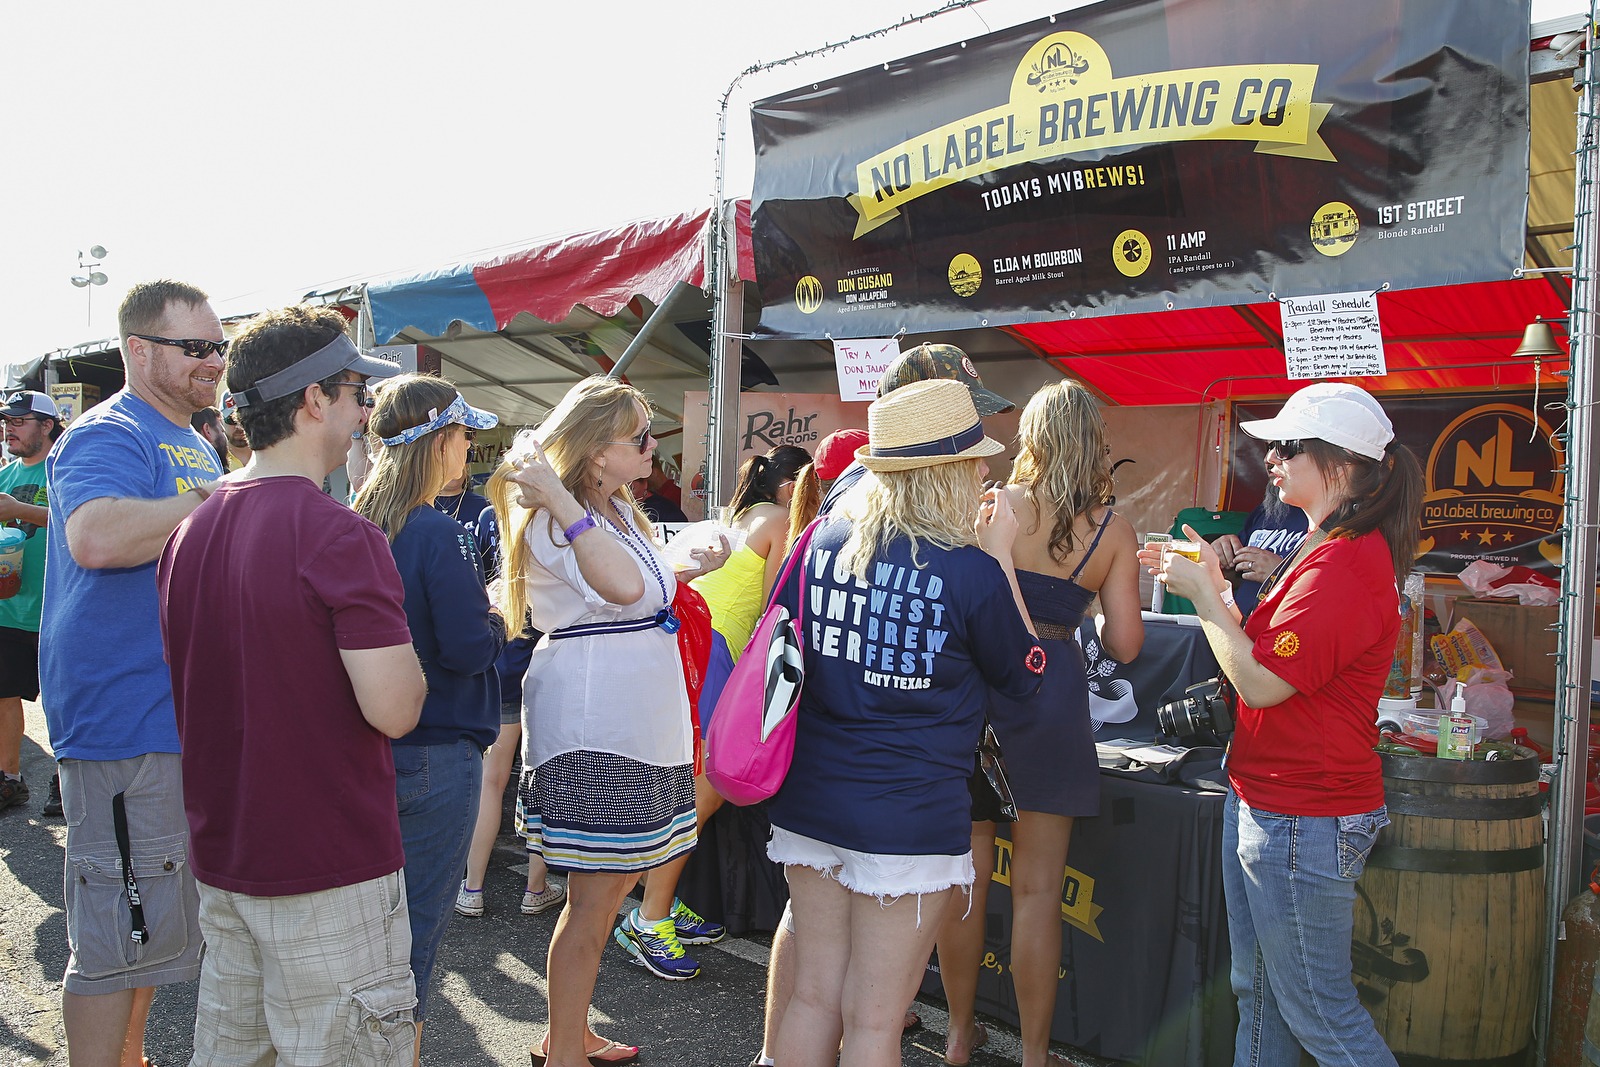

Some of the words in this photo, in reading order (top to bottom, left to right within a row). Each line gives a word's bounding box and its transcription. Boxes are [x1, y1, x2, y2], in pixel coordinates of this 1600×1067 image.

[1047, 47, 1066, 68] NL
[870, 153, 912, 202] NO
[922, 114, 1024, 181] LABEL
[1038, 79, 1220, 146] BREWING
[1231, 78, 1292, 126] CO
[981, 178, 1042, 211] TODAYS
[1048, 165, 1145, 194] MVBREWS!
[1378, 205, 1402, 224] 1ST
[1408, 196, 1464, 220] STREET
[1166, 234, 1176, 250] 11
[1180, 231, 1206, 250] AMP
[1378, 228, 1408, 240] Blonde
[1411, 223, 1444, 236] Randall
[993, 257, 1020, 274] ELDA
[1022, 254, 1032, 270] M
[1034, 248, 1082, 268] BOURBON
[1168, 256, 1181, 264] IPA
[1184, 252, 1211, 262] Randall
[1202, 264, 1215, 272] goes
[848, 267, 880, 276] PRESENTING
[996, 277, 1014, 285] Barrel
[1016, 275, 1030, 284] Aged
[1032, 273, 1046, 281] Milk
[1048, 271, 1064, 279] Stout
[838, 278, 855, 292] DON
[858, 273, 893, 290] GUSANO
[846, 294, 858, 304] DON
[859, 289, 888, 302] JALAPEÑO
[1287, 300, 1326, 314] Randall
[1332, 298, 1370, 309] Schedule
[838, 306, 850, 314] Aged
[859, 303, 876, 311] Mezcal
[840, 347, 858, 360] TRY
[865, 351, 872, 360] A
[844, 366, 864, 374] DON
[866, 364, 889, 374] JALAP
[742, 408, 818, 450] Rahr
[159, 443, 215, 474] THERE
[1454, 417, 1534, 487] NL
[1425, 505, 1442, 518] no
[1444, 504, 1478, 518] label
[1481, 504, 1534, 522] brewing
[1536, 509, 1554, 520] co.
[1481, 554, 1510, 562] BREWED
[875, 562, 943, 600] WILD
[811, 584, 866, 626] UNT
[870, 588, 945, 626] WEST
[812, 620, 861, 663] EER
[868, 616, 948, 652] BREW
[866, 644, 935, 675] FEST
[864, 670, 891, 688] KATY
[893, 675, 932, 690] TEXAS
[128, 882, 141, 906] UFC
[1062, 875, 1080, 908] O
